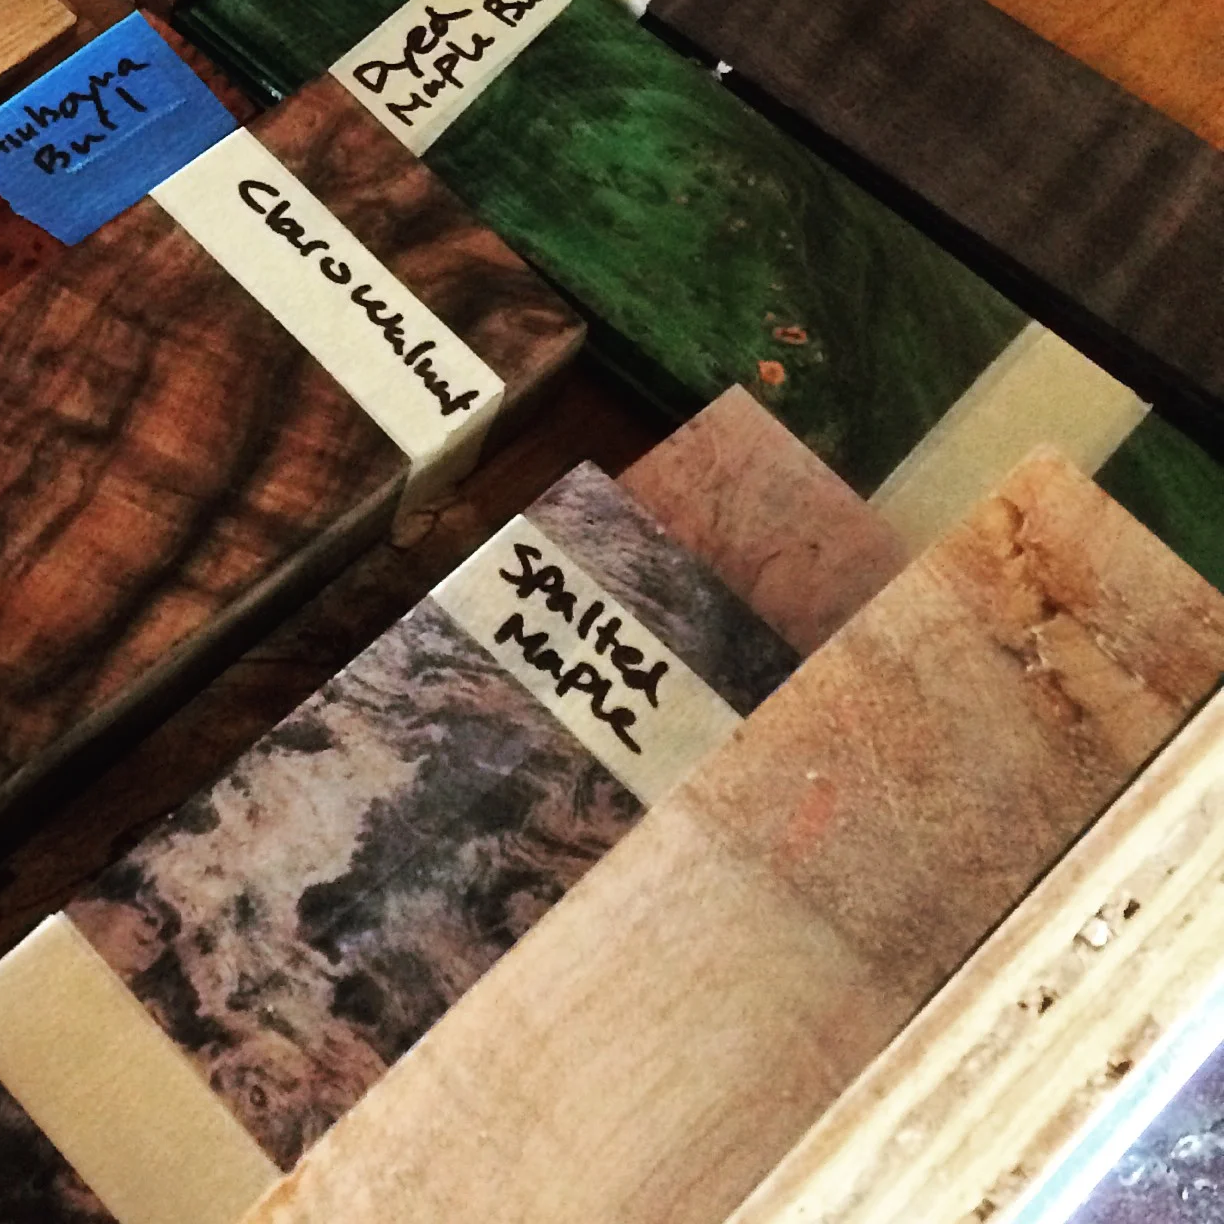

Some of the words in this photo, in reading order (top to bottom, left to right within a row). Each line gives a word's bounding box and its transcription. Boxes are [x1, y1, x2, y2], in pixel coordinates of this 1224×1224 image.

[352, 5, 473, 94] Dyed
[385, 32, 495, 126] Maple
[494, 612, 642, 755] Maple
